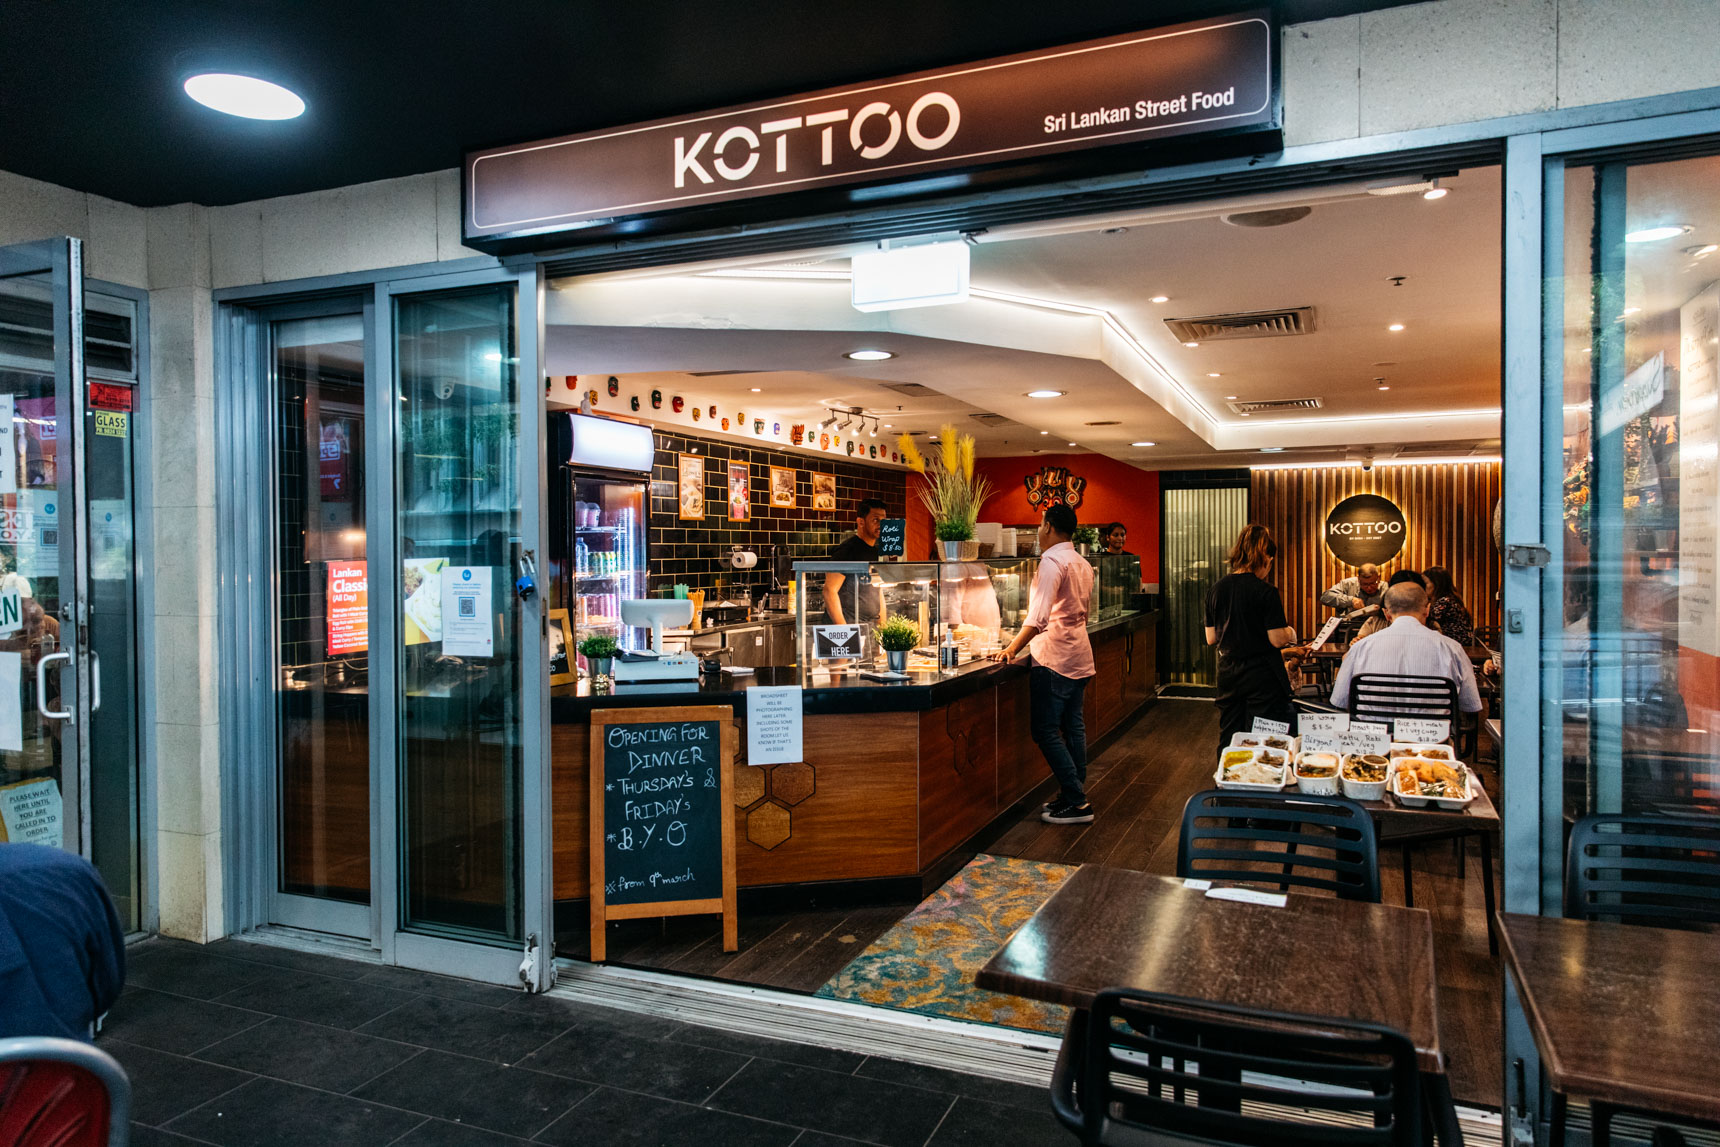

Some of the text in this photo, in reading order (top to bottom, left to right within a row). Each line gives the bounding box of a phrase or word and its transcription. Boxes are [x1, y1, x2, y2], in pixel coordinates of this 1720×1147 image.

[1044, 87, 1234, 133] Sri Lankan Street Food
[674, 91, 961, 188] KOTTOO
[97, 415, 125, 428] GLASS
[1330, 521, 1401, 535] KOTTOO
[333, 568, 362, 578] Lankan
[333, 578, 368, 593] Classi
[333, 593, 357, 603] (All Day)
[829, 632, 848, 640] ORDER
[831, 646, 850, 656] HERE
[609, 723, 709, 748] OPENING FOR
[628, 746, 706, 774] DINNER
[704, 768, 717, 788] &
[10, 789, 50, 803] PLEASE WAIT
[14, 798, 50, 812] HERE UNTIL
[20, 812, 33, 820] YOU
[15, 820, 37, 830] CALLED
[26, 826, 48, 837] ORDER
[618, 876, 645, 892] from
[662, 867, 696, 884] march
